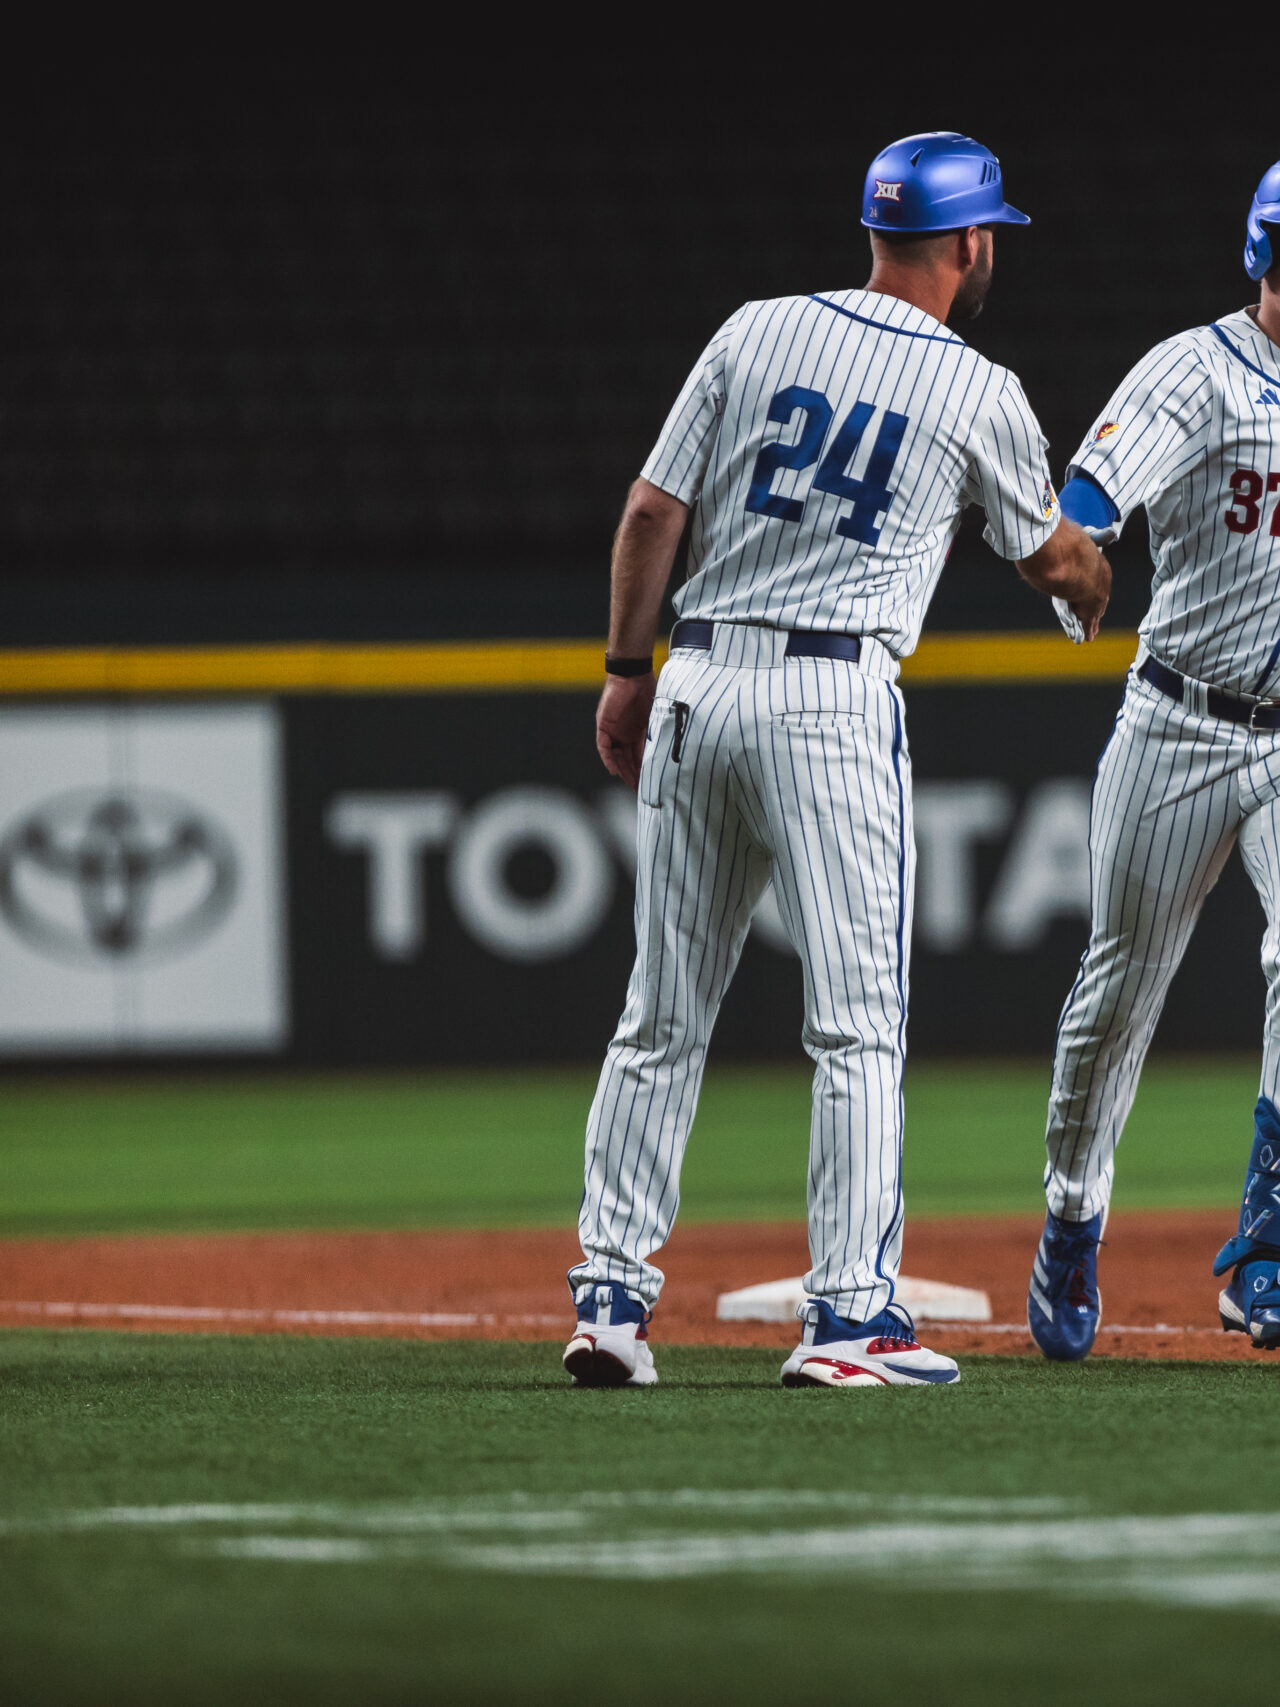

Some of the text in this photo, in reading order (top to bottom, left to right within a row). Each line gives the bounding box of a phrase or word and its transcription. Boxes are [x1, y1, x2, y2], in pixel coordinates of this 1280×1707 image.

[873, 179, 903, 202] XII
[744, 384, 910, 547] 24
[327, 782, 1092, 955] TOTA
